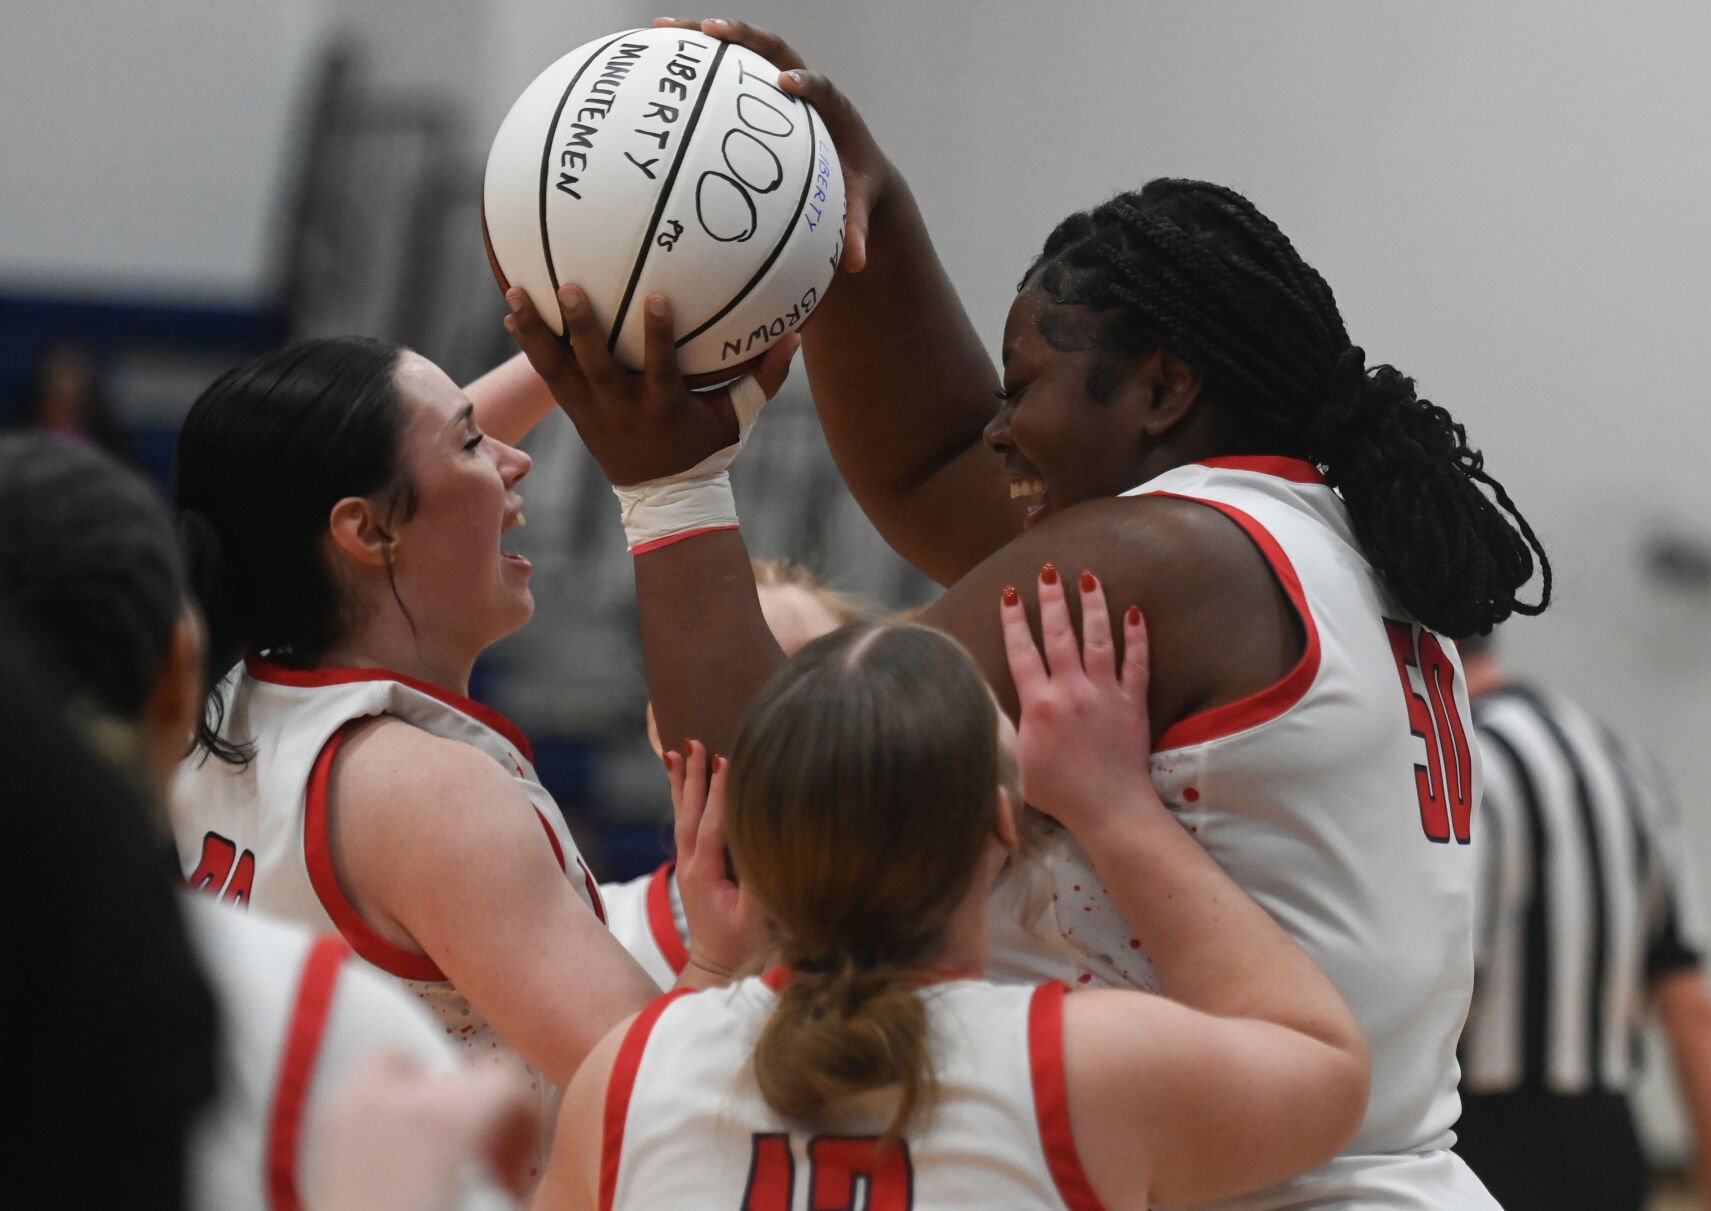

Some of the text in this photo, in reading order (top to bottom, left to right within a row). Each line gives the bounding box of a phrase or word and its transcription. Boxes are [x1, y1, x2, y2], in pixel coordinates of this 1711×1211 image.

[556, 43, 649, 200] MINUTEMEN
[624, 40, 708, 180] LIBERTY
[695, 59, 796, 243] 1000
[805, 139, 830, 232] LIBERTY
[721, 287, 817, 361] BROWN
[1382, 616, 1471, 845] 50
